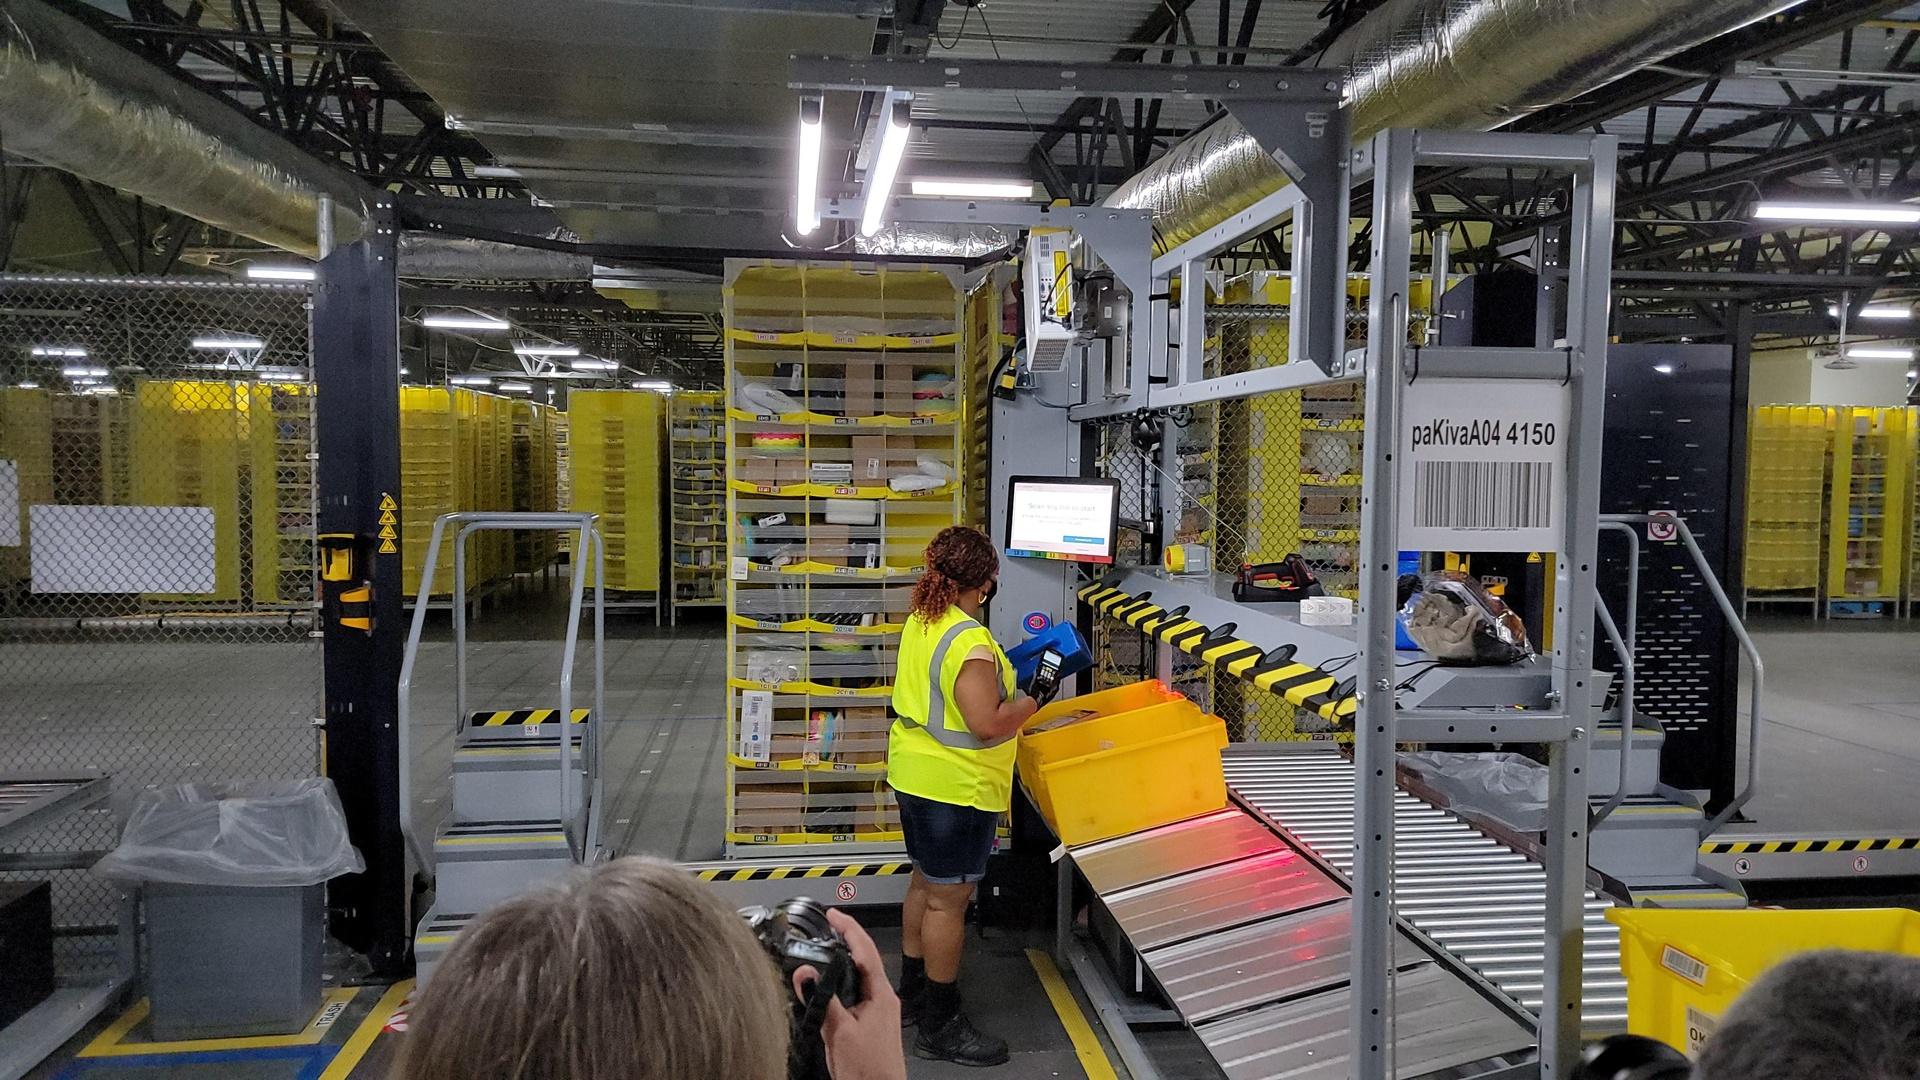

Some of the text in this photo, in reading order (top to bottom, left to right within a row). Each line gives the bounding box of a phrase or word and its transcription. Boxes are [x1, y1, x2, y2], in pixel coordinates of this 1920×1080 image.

[1412, 418, 1556, 452] paKivaA04 4150
[315, 1002, 345, 1026] TRASH
